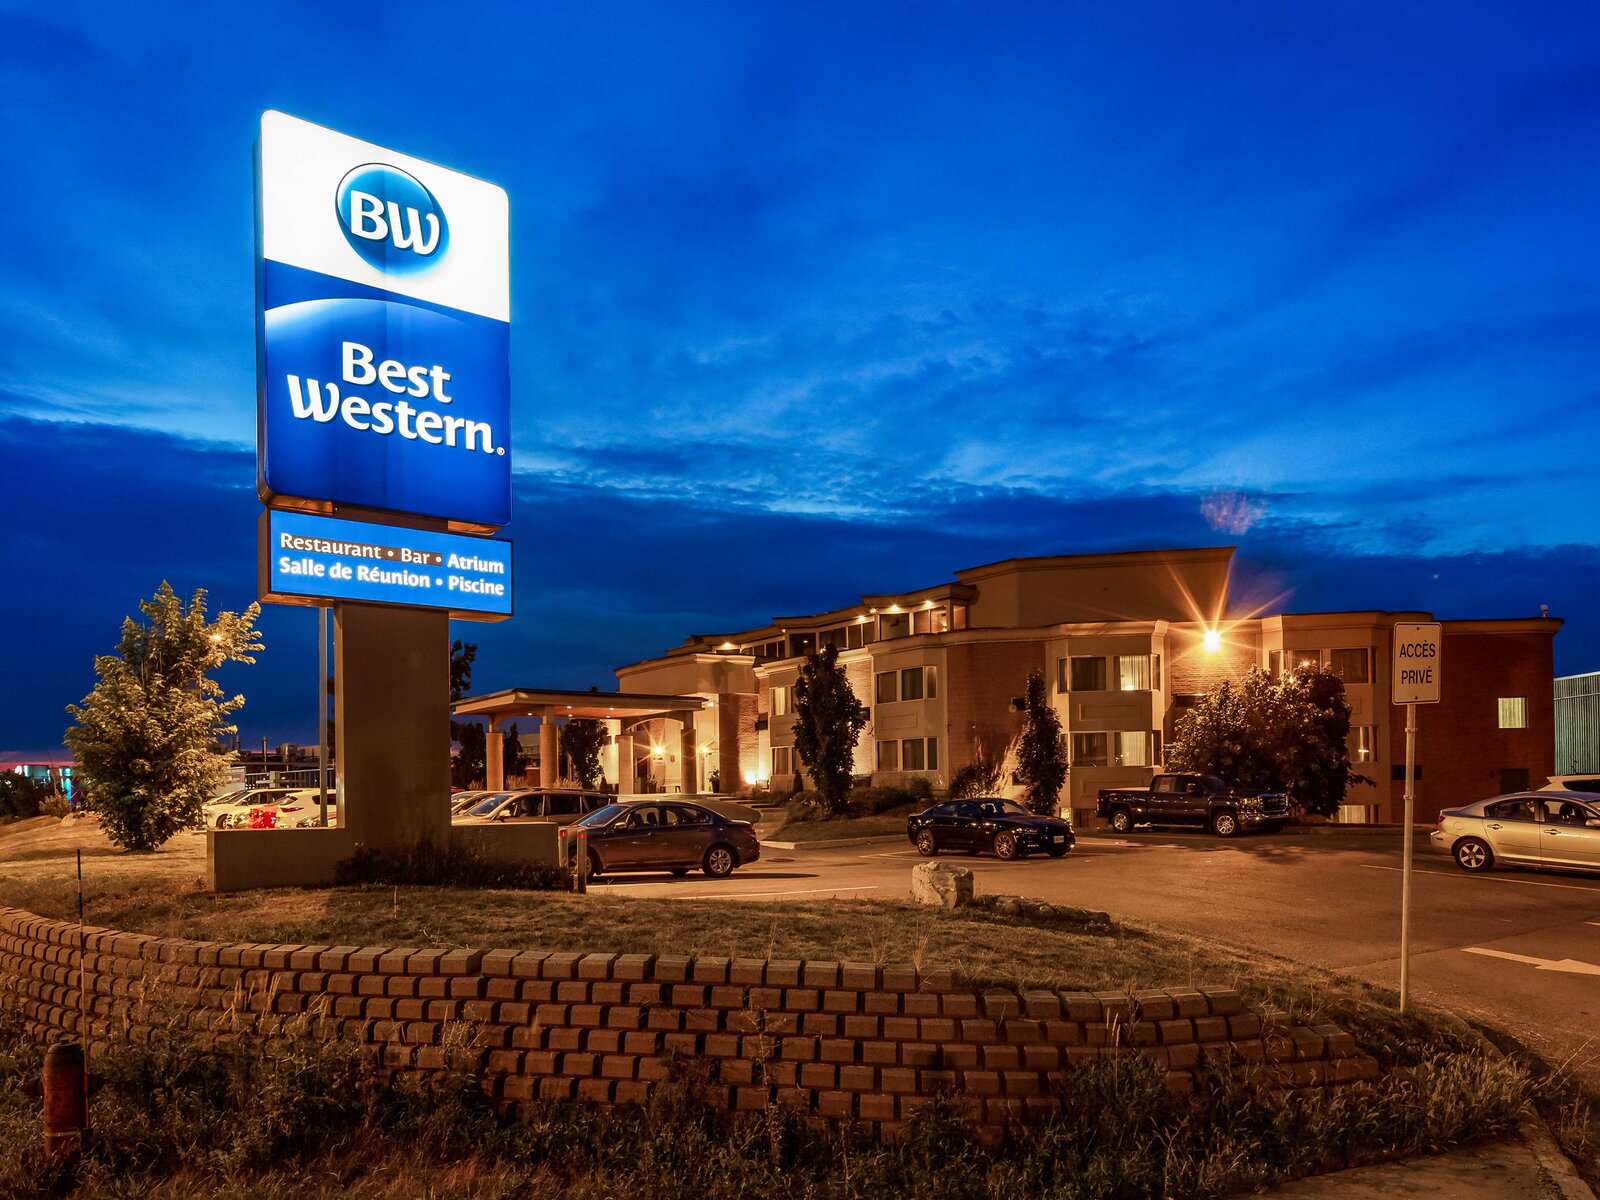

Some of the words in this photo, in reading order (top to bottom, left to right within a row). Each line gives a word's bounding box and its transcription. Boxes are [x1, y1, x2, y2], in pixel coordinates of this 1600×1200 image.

[350, 190, 440, 255] BW
[341, 341, 453, 404] Best
[280, 532, 382, 560] Restaurant
[401, 547, 431, 565] Bar
[447, 553, 505, 574] Atrium
[279, 556, 326, 578] Salle
[329, 562, 353, 580] de
[357, 564, 431, 588] Réunion
[448, 575, 505, 597] Piscine
[1399, 639, 1436, 659] ACCÈS
[1401, 665, 1433, 685] PRIVÉ
